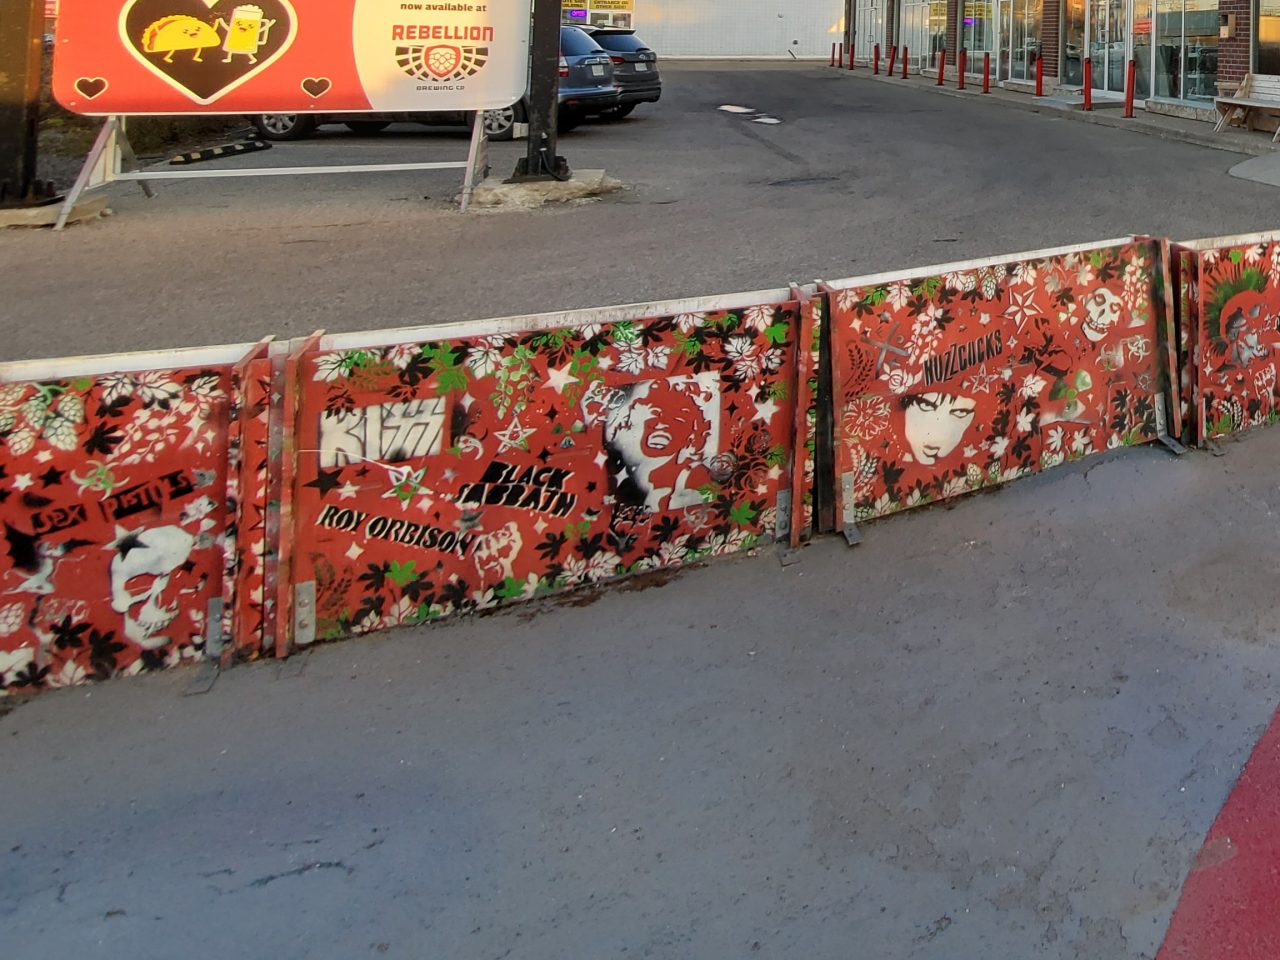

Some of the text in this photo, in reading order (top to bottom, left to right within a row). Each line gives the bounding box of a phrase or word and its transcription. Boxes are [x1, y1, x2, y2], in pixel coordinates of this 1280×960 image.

[400, 2, 487, 12] now available at
[391, 24, 494, 42] REBELLION
[320, 396, 446, 468] KISS
[479, 459, 576, 492] BLACK
[315, 503, 483, 560] ROY ORBISON
